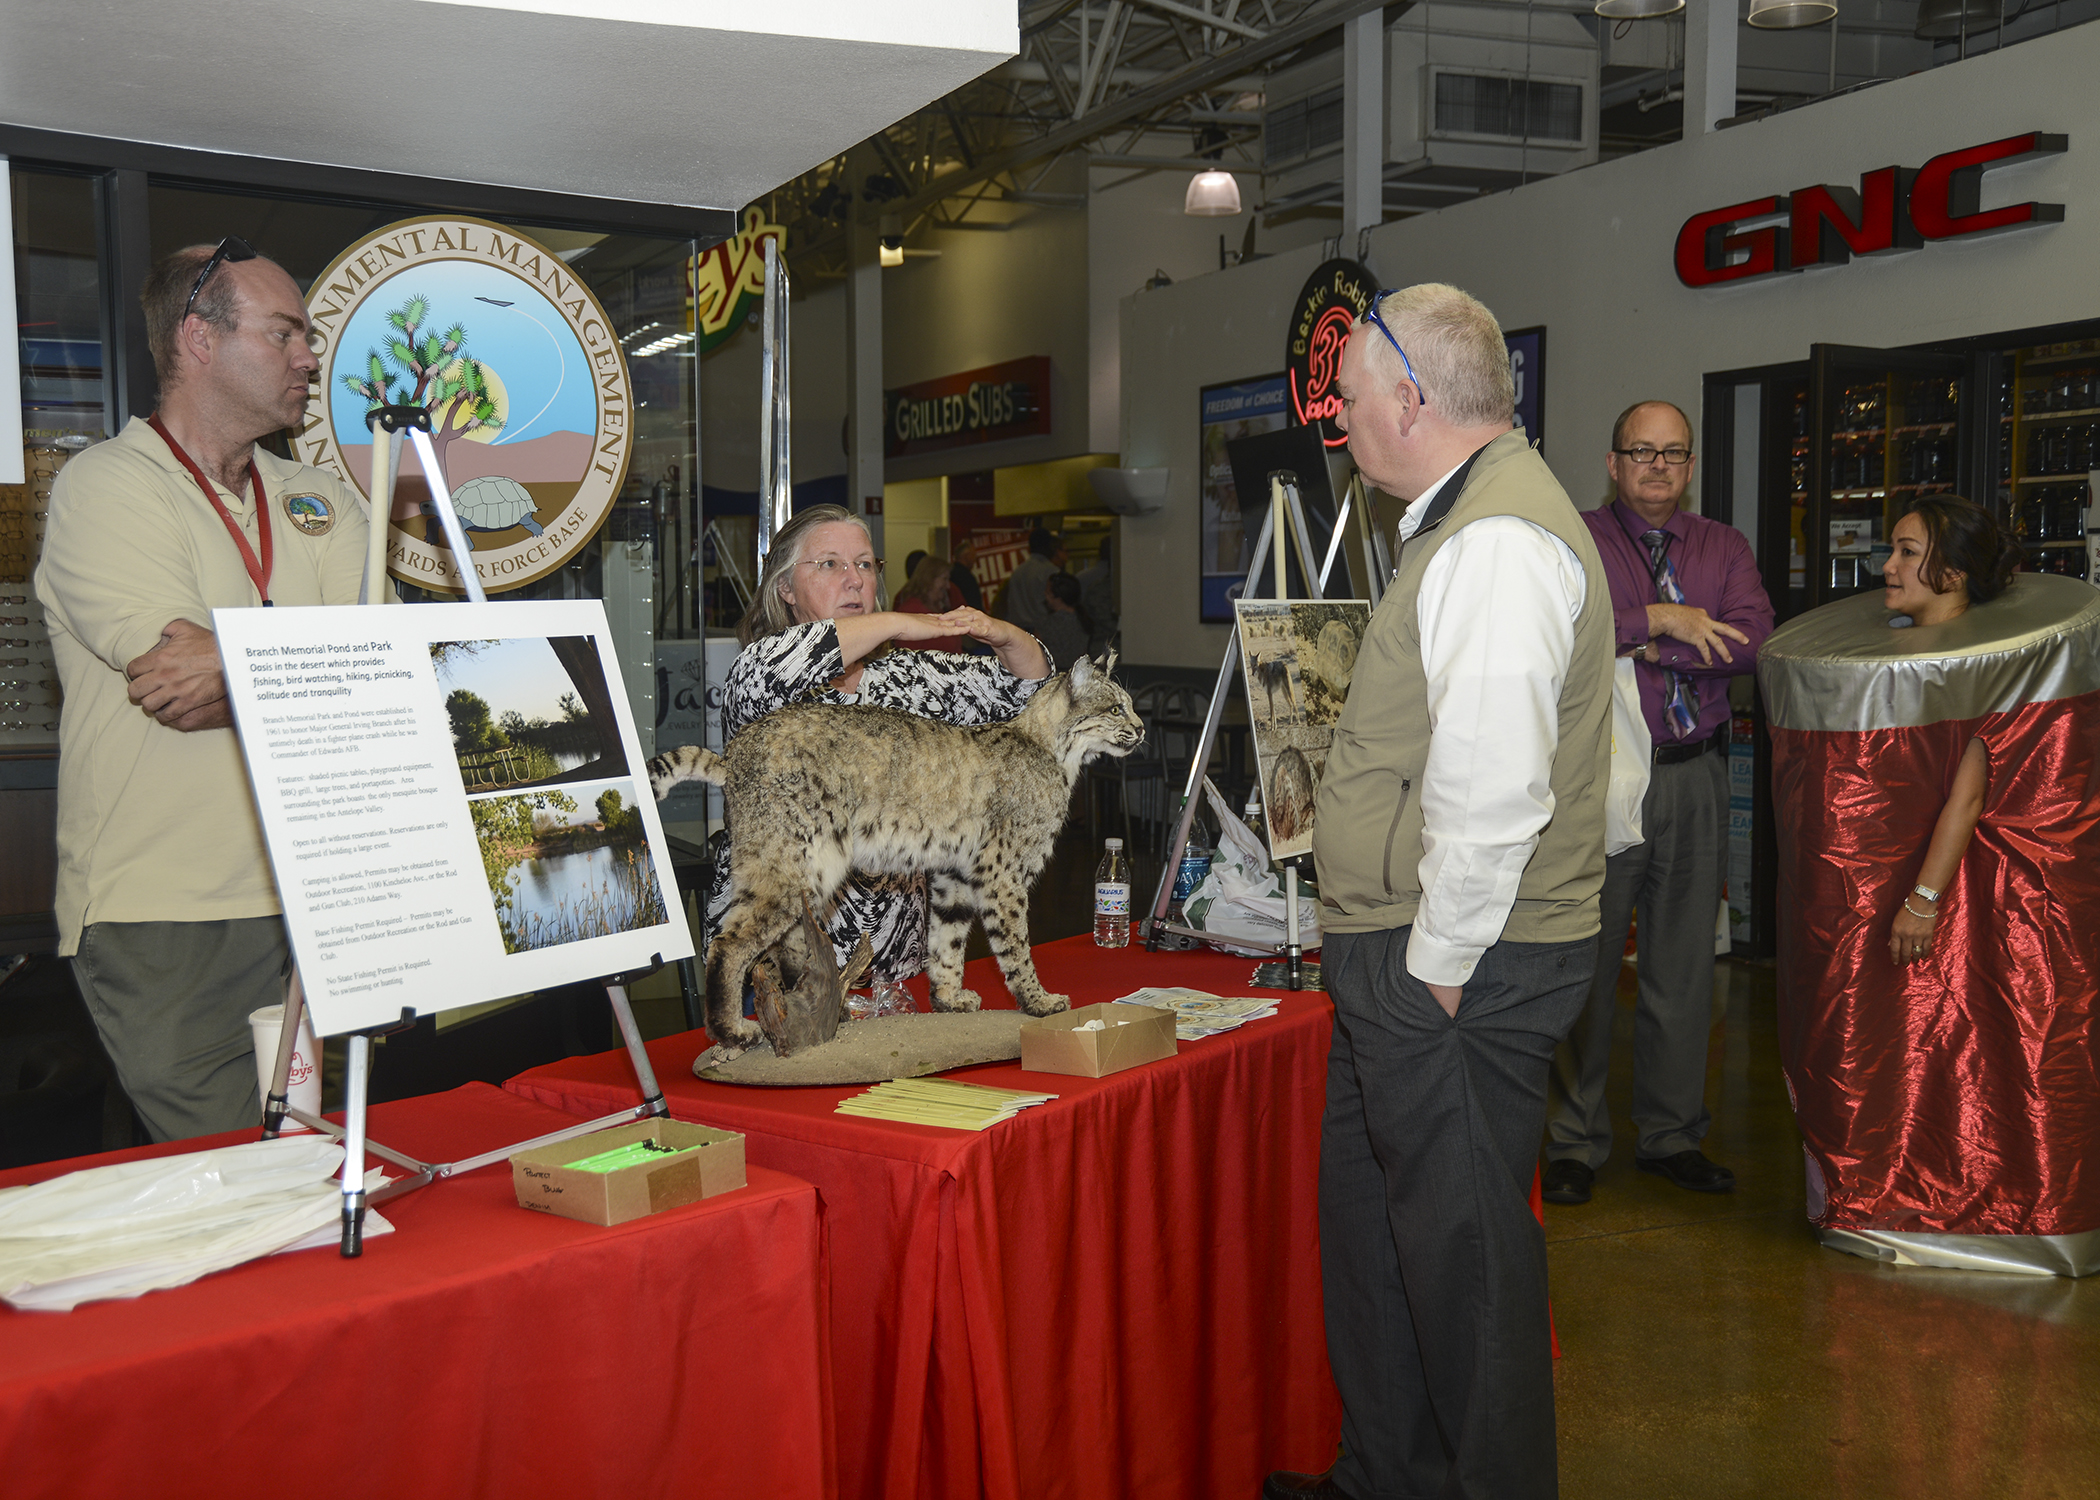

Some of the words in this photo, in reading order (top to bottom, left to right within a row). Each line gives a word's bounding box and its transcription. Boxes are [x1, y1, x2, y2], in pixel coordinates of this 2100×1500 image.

[1674, 131, 2068, 289] GNC
[1293, 285, 1328, 356] Baskin
[487, 232, 625, 485] MANAGEMENT
[895, 393, 965, 441] GRILLED
[967, 381, 1014, 430] SUBS
[1206, 395, 1244, 415] FREEDOM
[1254, 388, 1285, 404] CHOICE
[1305, 399, 1322, 420] Ice
[452, 564, 486, 579] AR
[490, 544, 550, 577] FORCE
[548, 506, 588, 549] BASE
[971, 548, 1031, 585] HILL
[246, 646, 279, 657] Branch
[281, 644, 326, 656] Memorial
[327, 643, 351, 654] Pond
[370, 641, 392, 651] Park
[250, 663, 273, 672] Oasis
[284, 662, 298, 670] the
[300, 661, 325, 670] desert
[327, 659, 351, 668] which
[352, 659, 385, 667] provides
[253, 676, 284, 688] fishing,
[286, 675, 303, 684] bird
[304, 674, 344, 684] watching,
[346, 671, 372, 682] hiking,
[374, 671, 414, 680] picnicking,
[257, 690, 290, 700] solitude
[292, 690, 308, 698] and
[310, 686, 352, 697] tranquility
[262, 716, 285, 724] Branch
[286, 714, 316, 722] Memorial
[344, 710, 360, 718] Pond
[375, 707, 407, 716] established
[666, 720, 700, 730] JEWELRY
[309, 724, 327, 734] Major
[328, 722, 352, 731] General
[353, 721, 371, 730] Irving
[371, 719, 393, 728] Branch
[393, 718, 407, 726] after
[271, 750, 309, 759] Commander
[310, 748, 317, 756] of
[318, 746, 344, 755] Edwards
[308, 772, 330, 781] shaded
[369, 765, 402, 776] playground
[280, 788, 297, 797] BBQ
[315, 785, 331, 794] large
[292, 839, 310, 848] Open
[328, 834, 351, 842] without
[389, 824, 425, 835] Reservations
[435, 820, 448, 830] only
[296, 852, 322, 860] required
[328, 846, 352, 857] holding
[358, 844, 373, 853] large
[302, 877, 331, 888] Camping
[364, 867, 387, 877] Permits
[388, 866, 400, 875] may
[409, 860, 434, 870] obtained
[434, 858, 449, 866] from
[1176, 870, 1206, 886] ASA
[305, 889, 331, 899] Outdoor
[367, 880, 382, 889] 1100
[435, 871, 445, 879] the
[445, 869, 458, 878] Rod
[309, 904, 320, 912] and
[321, 901, 335, 910] Gun
[353, 896, 366, 905] 210
[366, 894, 387, 903] Adams
[314, 928, 330, 938] Base
[331, 924, 355, 936] Fishing
[354, 920, 375, 931] Permit
[375, 916, 402, 927] Required
[410, 910, 432, 921] Permits
[432, 910, 445, 919] may
[317, 938, 344, 949] obtained
[345, 935, 360, 944] from
[360, 931, 386, 942] Outdoor
[386, 925, 418, 937] Recreation
[425, 922, 435, 930] the
[435, 919, 448, 928] Rod
[448, 917, 459, 926] and
[459, 915, 472, 924] Gun
[326, 976, 336, 985] No
[337, 973, 353, 983] State
[354, 968, 377, 981] Fishing
[377, 965, 397, 975] Permit
[329, 988, 340, 997] No
[340, 984, 372, 995] swimming
[380, 977, 404, 988] hunting
